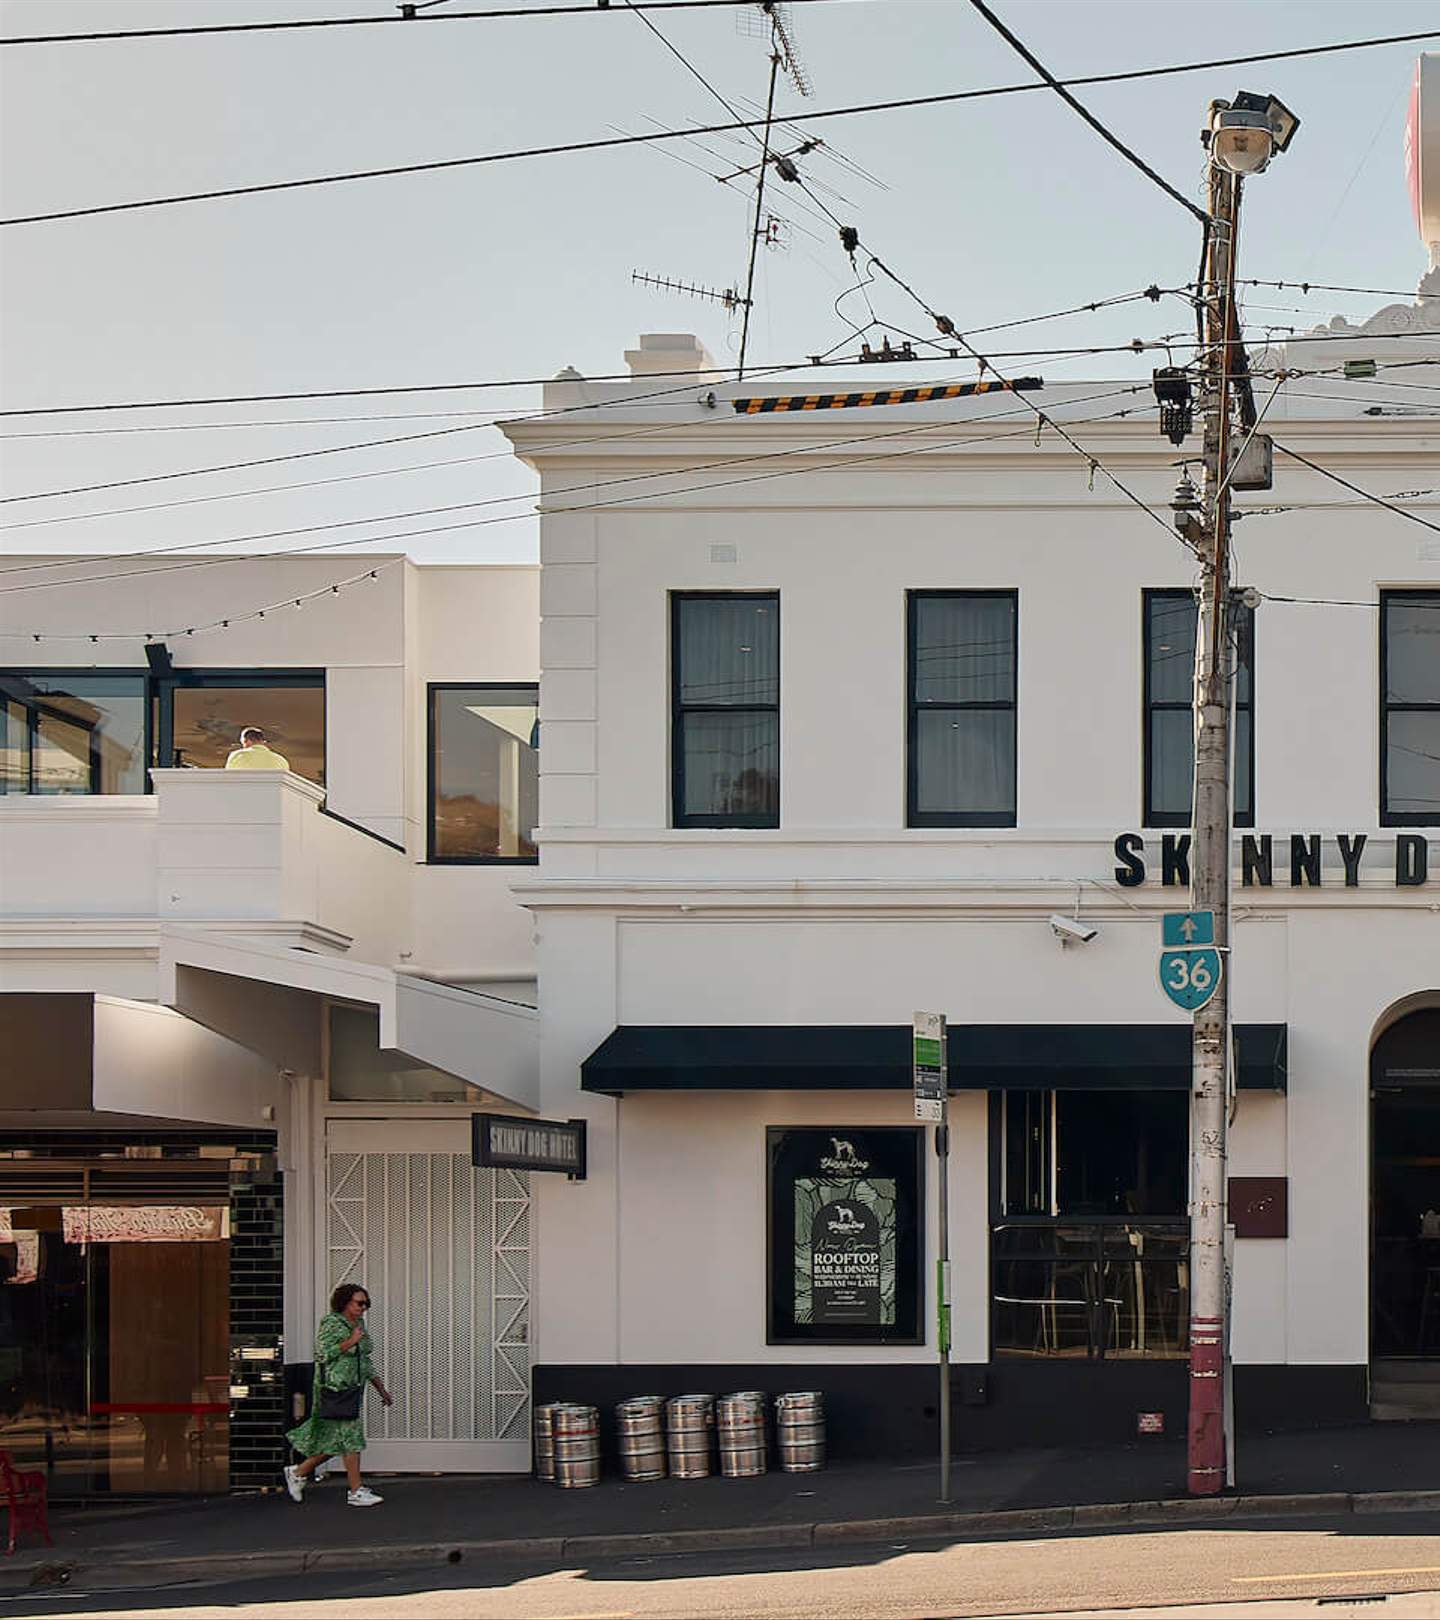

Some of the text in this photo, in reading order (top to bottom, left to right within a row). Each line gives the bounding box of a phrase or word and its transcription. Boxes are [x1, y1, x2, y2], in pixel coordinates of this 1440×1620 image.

[1114, 833, 1368, 888] SKNNY
[1168, 957, 1212, 992] 36
[490, 1126, 577, 1160] SKINNY DOG HOTEL
[813, 1252, 879, 1265] ROOFTOP
[814, 1265, 833, 1274] BAR
[843, 1264, 880, 1274] DINING
